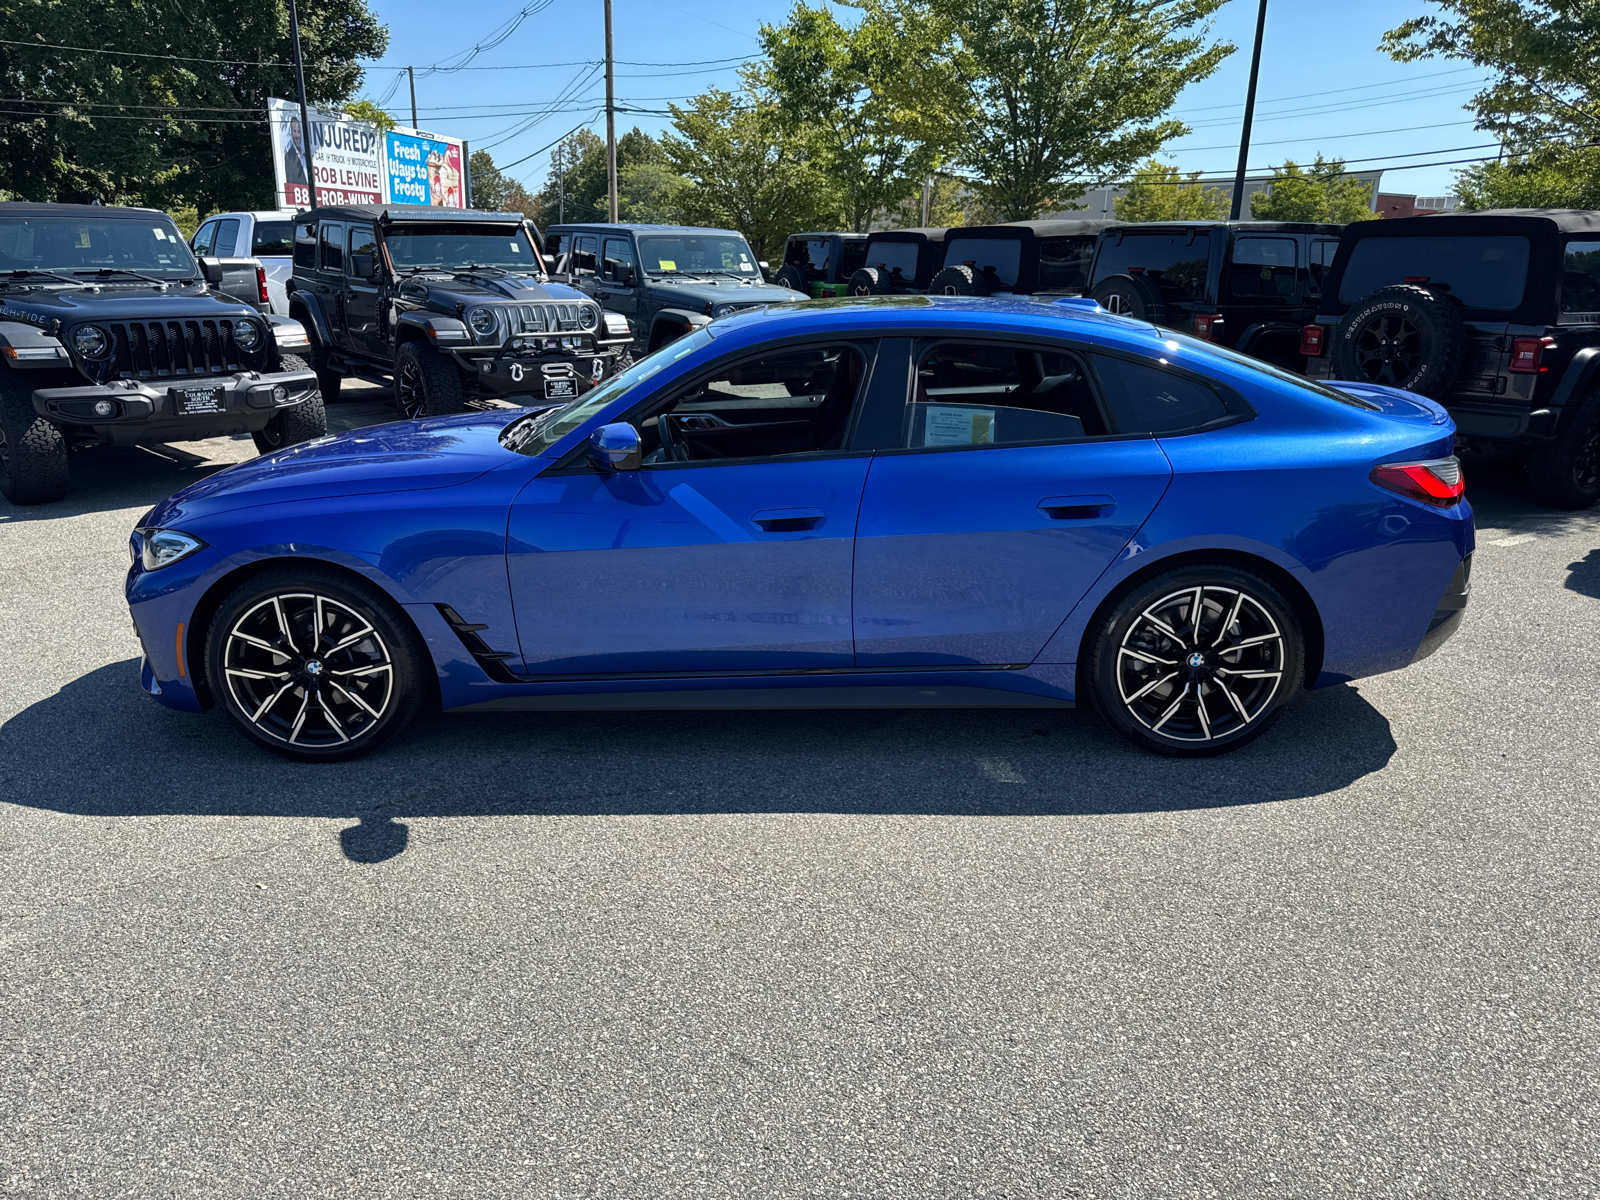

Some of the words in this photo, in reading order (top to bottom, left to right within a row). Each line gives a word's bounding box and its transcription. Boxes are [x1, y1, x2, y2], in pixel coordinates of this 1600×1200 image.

[315, 152, 324, 161] CAR
[331, 153, 345, 164] TRUCK
[351, 157, 377, 168] MOTORCYCLE
[393, 140, 421, 161] Fresh
[313, 166, 337, 184] ROB
[340, 169, 378, 188] LEVINE
[389, 158, 416, 182] Ways
[416, 163, 427, 180] to
[293, 187, 375, 206] 88-ROB-WINS
[394, 177, 425, 202] Frosty
[21, 311, 46, 323] TIDE
[1345, 302, 1402, 340] DESTINATION
